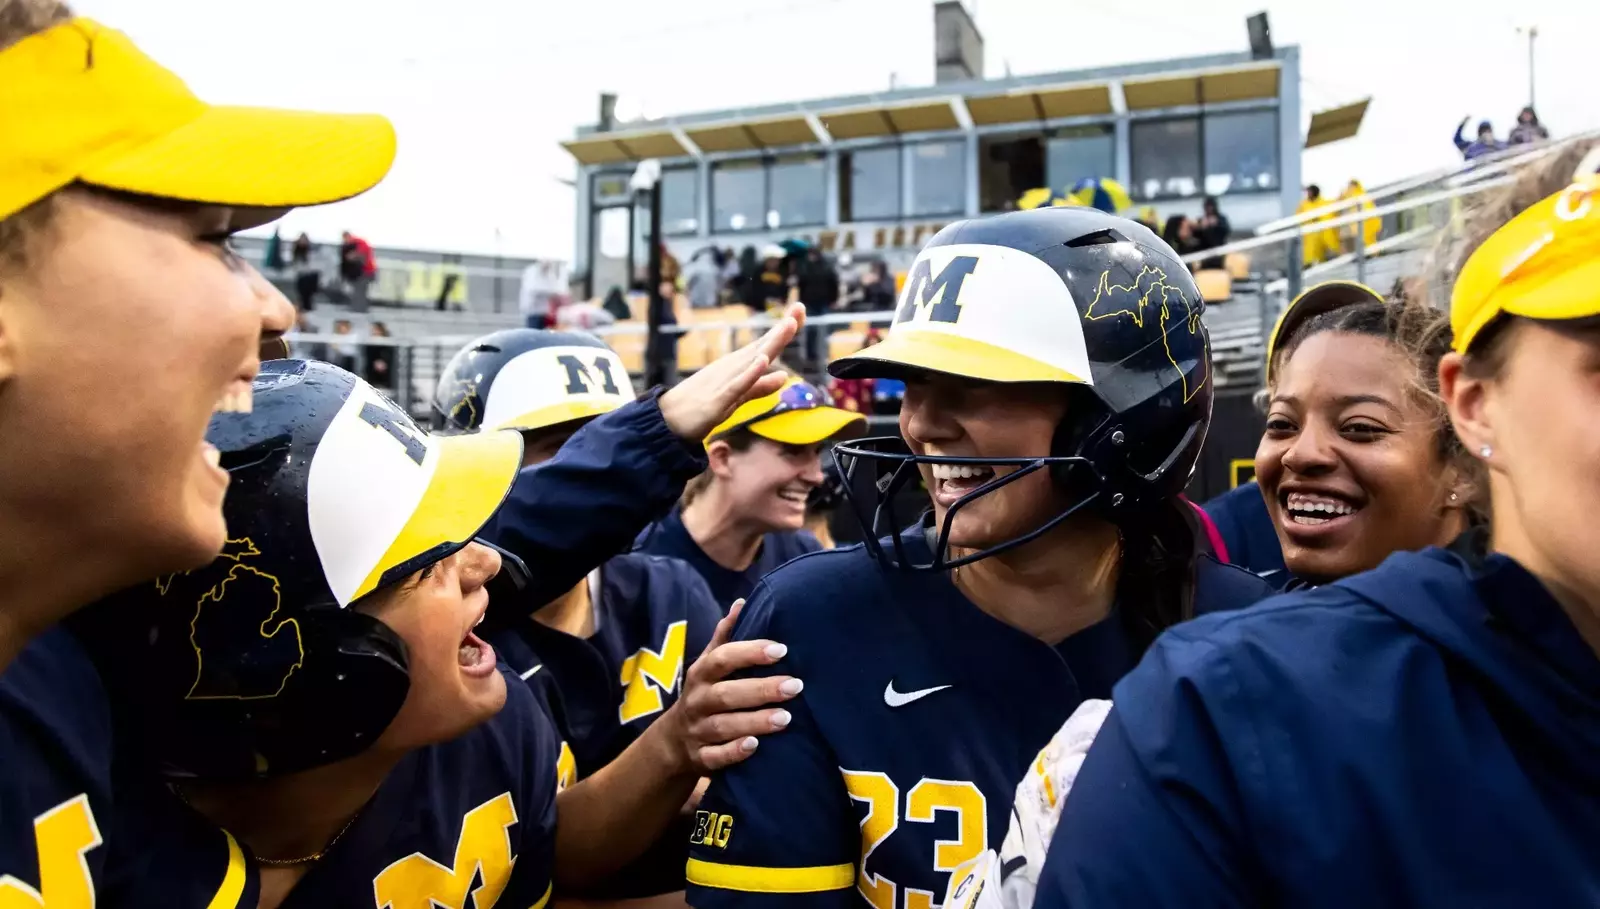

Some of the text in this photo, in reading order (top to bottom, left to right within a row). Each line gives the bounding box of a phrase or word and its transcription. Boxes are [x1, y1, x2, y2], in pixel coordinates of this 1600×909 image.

[898, 256, 979, 324] M
[557, 355, 620, 395] M
[619, 620, 688, 725] M
[838, 766, 988, 909] 23
